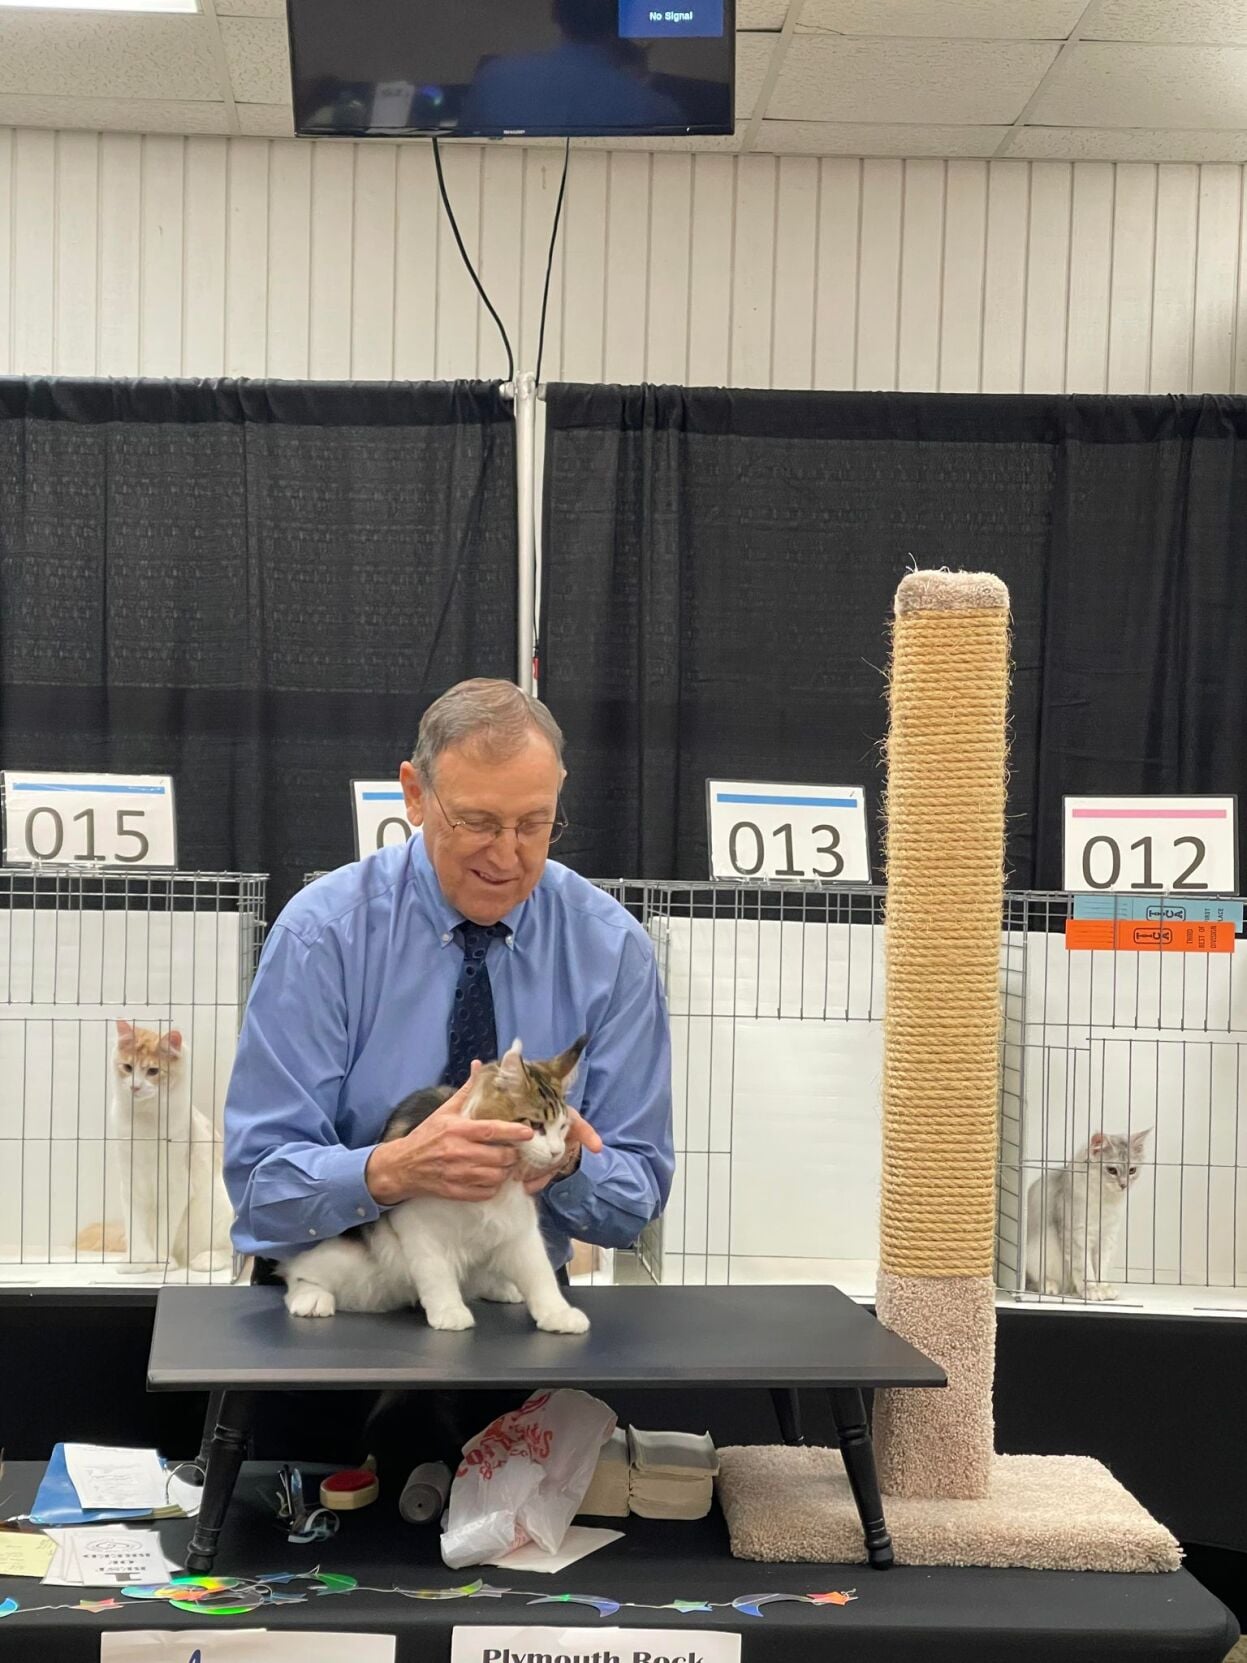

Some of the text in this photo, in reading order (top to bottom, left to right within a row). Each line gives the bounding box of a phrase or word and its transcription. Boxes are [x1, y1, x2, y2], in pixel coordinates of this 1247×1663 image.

[649, 11, 694, 22] No Signal
[25, 807, 149, 862] 015
[729, 821, 845, 878] 013
[1082, 835, 1209, 890] 012
[1136, 932, 1169, 940] TICA
